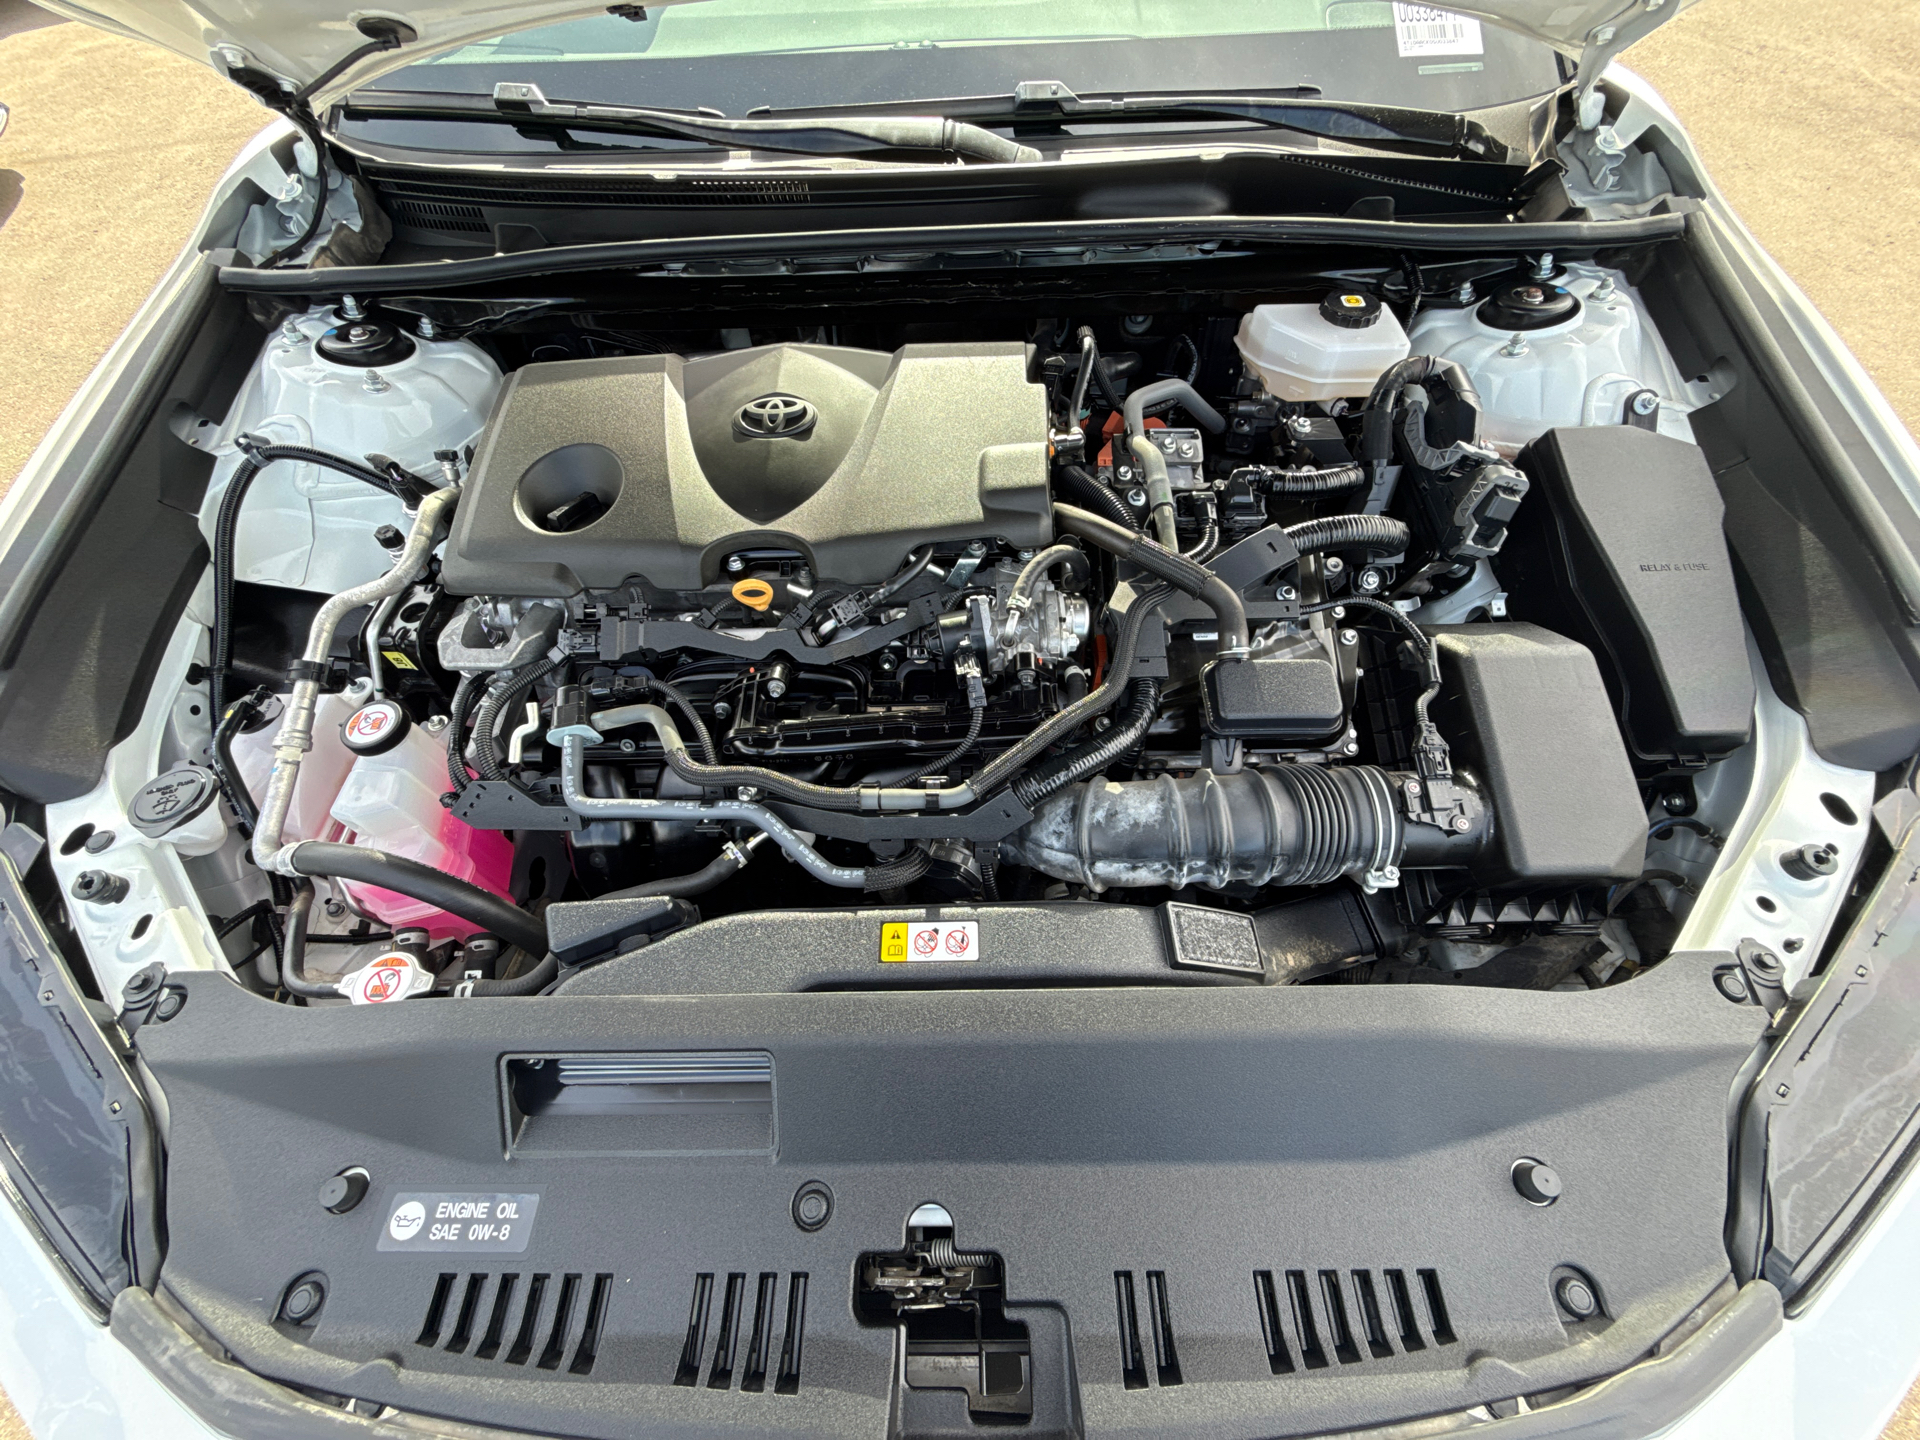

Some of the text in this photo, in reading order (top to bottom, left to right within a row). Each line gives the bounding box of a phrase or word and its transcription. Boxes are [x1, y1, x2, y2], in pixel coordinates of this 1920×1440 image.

[1640, 564, 1671, 572] RELAY
[1683, 563, 1710, 571] FUSE
[435, 1202, 519, 1219] ENGINE OIL
[429, 1223, 511, 1241] SAE 0W-8
